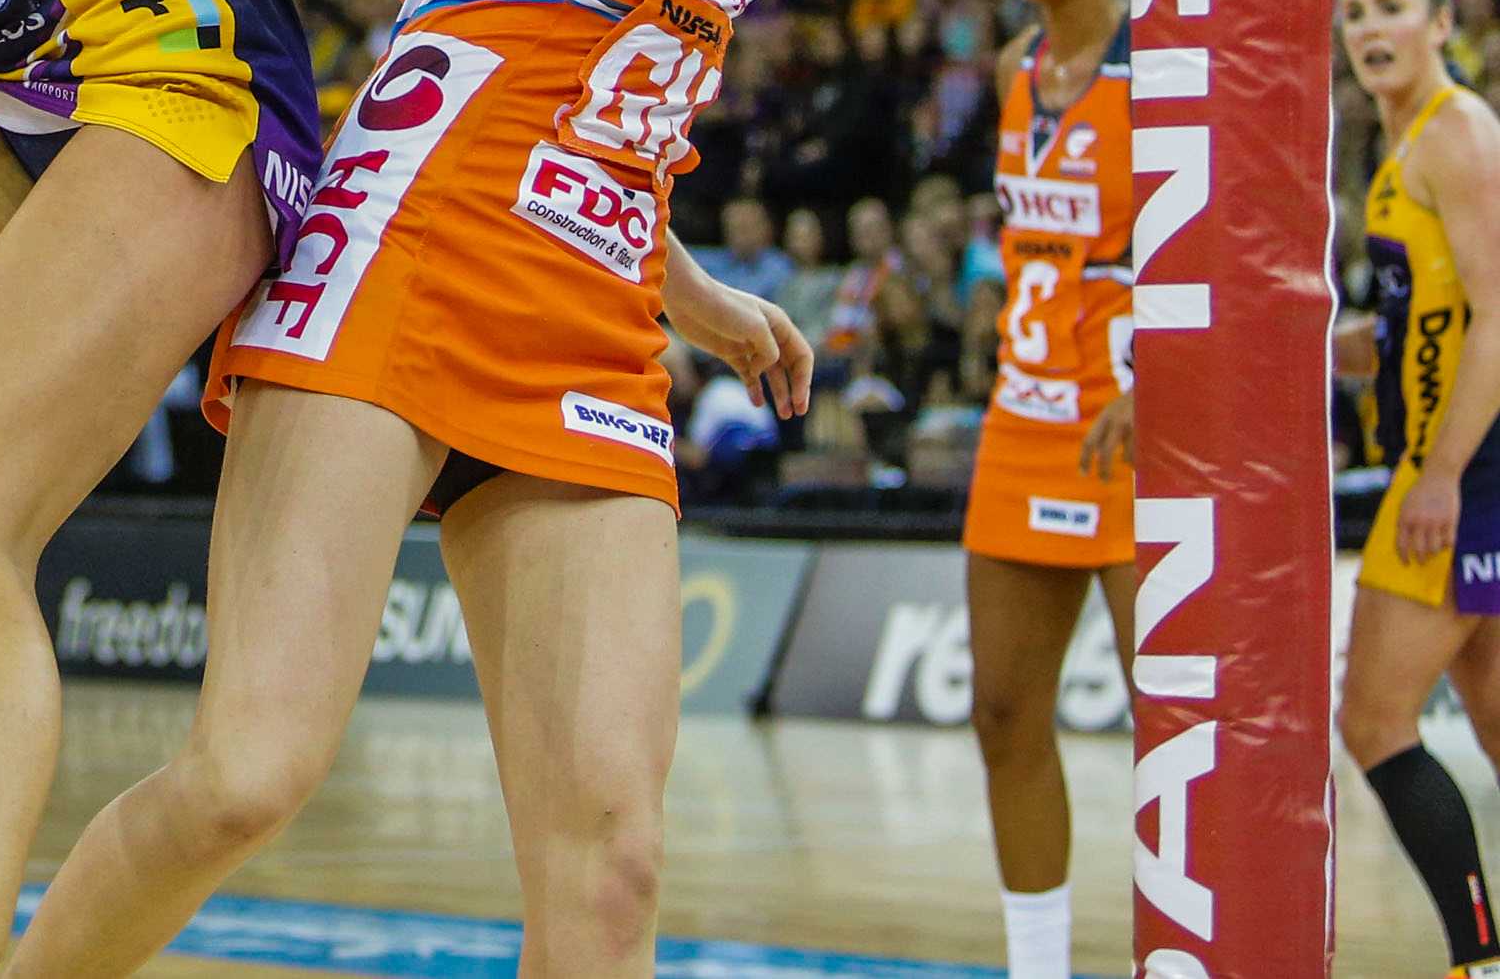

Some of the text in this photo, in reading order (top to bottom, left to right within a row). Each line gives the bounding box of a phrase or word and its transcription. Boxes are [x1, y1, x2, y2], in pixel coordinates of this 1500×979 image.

[30, 81, 76, 103] AIRPORT
[526, 199, 607, 250] construction
[605, 241, 619, 257] &
[531, 158, 648, 249] FDC
[1018, 189, 1092, 223] HCF
[266, 148, 390, 340] HCF
[1008, 260, 1061, 364] C
[574, 404, 669, 450] BING LEE
[1132, 497, 1217, 979] AN
